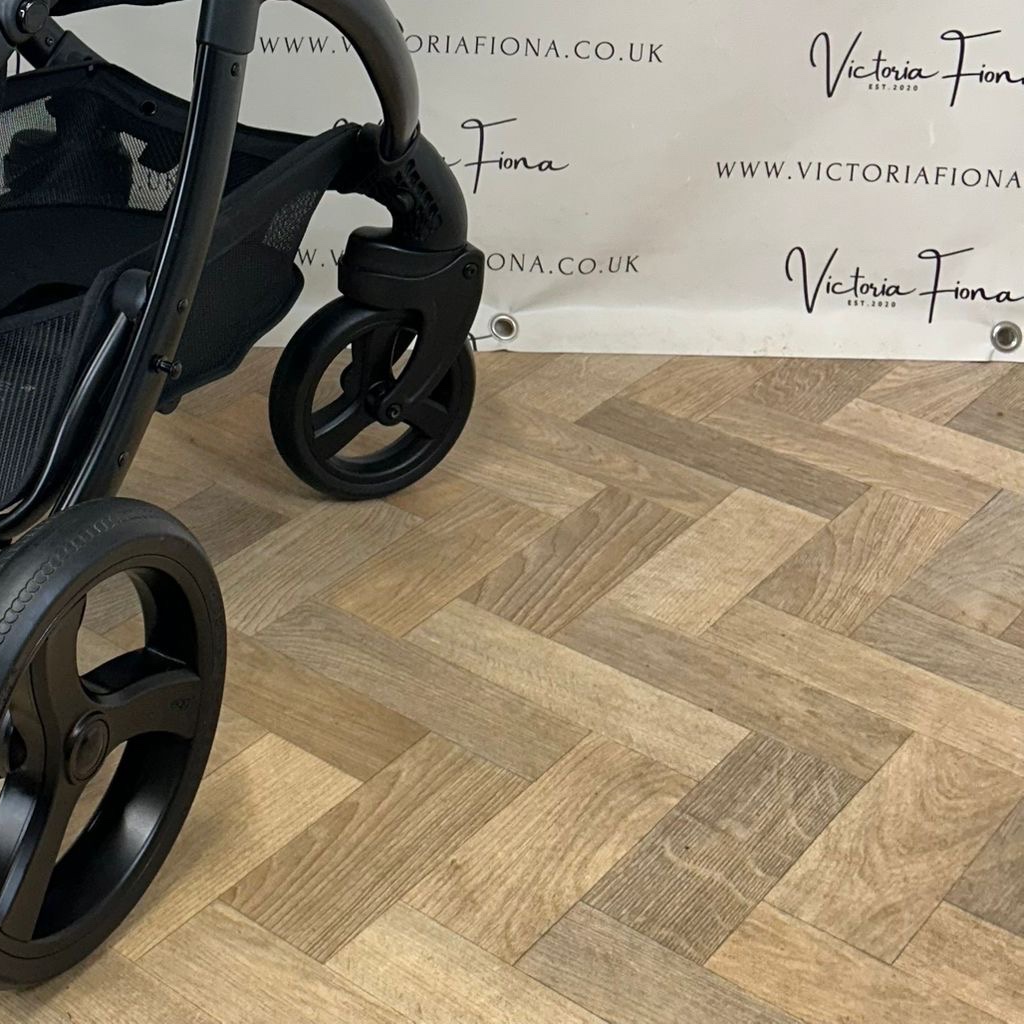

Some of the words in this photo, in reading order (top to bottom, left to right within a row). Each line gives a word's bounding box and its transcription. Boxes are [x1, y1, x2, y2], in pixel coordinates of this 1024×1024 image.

[810, 31, 939, 98] Victoria
[940, 29, 1024, 108] Fion
[461, 118, 569, 194] Fiona
[716, 161, 1022, 189] WWW.VICTORIAFIONA
[785, 246, 917, 314] Victoria
[918, 247, 1024, 324] Fiona
[847, 300, 897, 308] EST.2020
